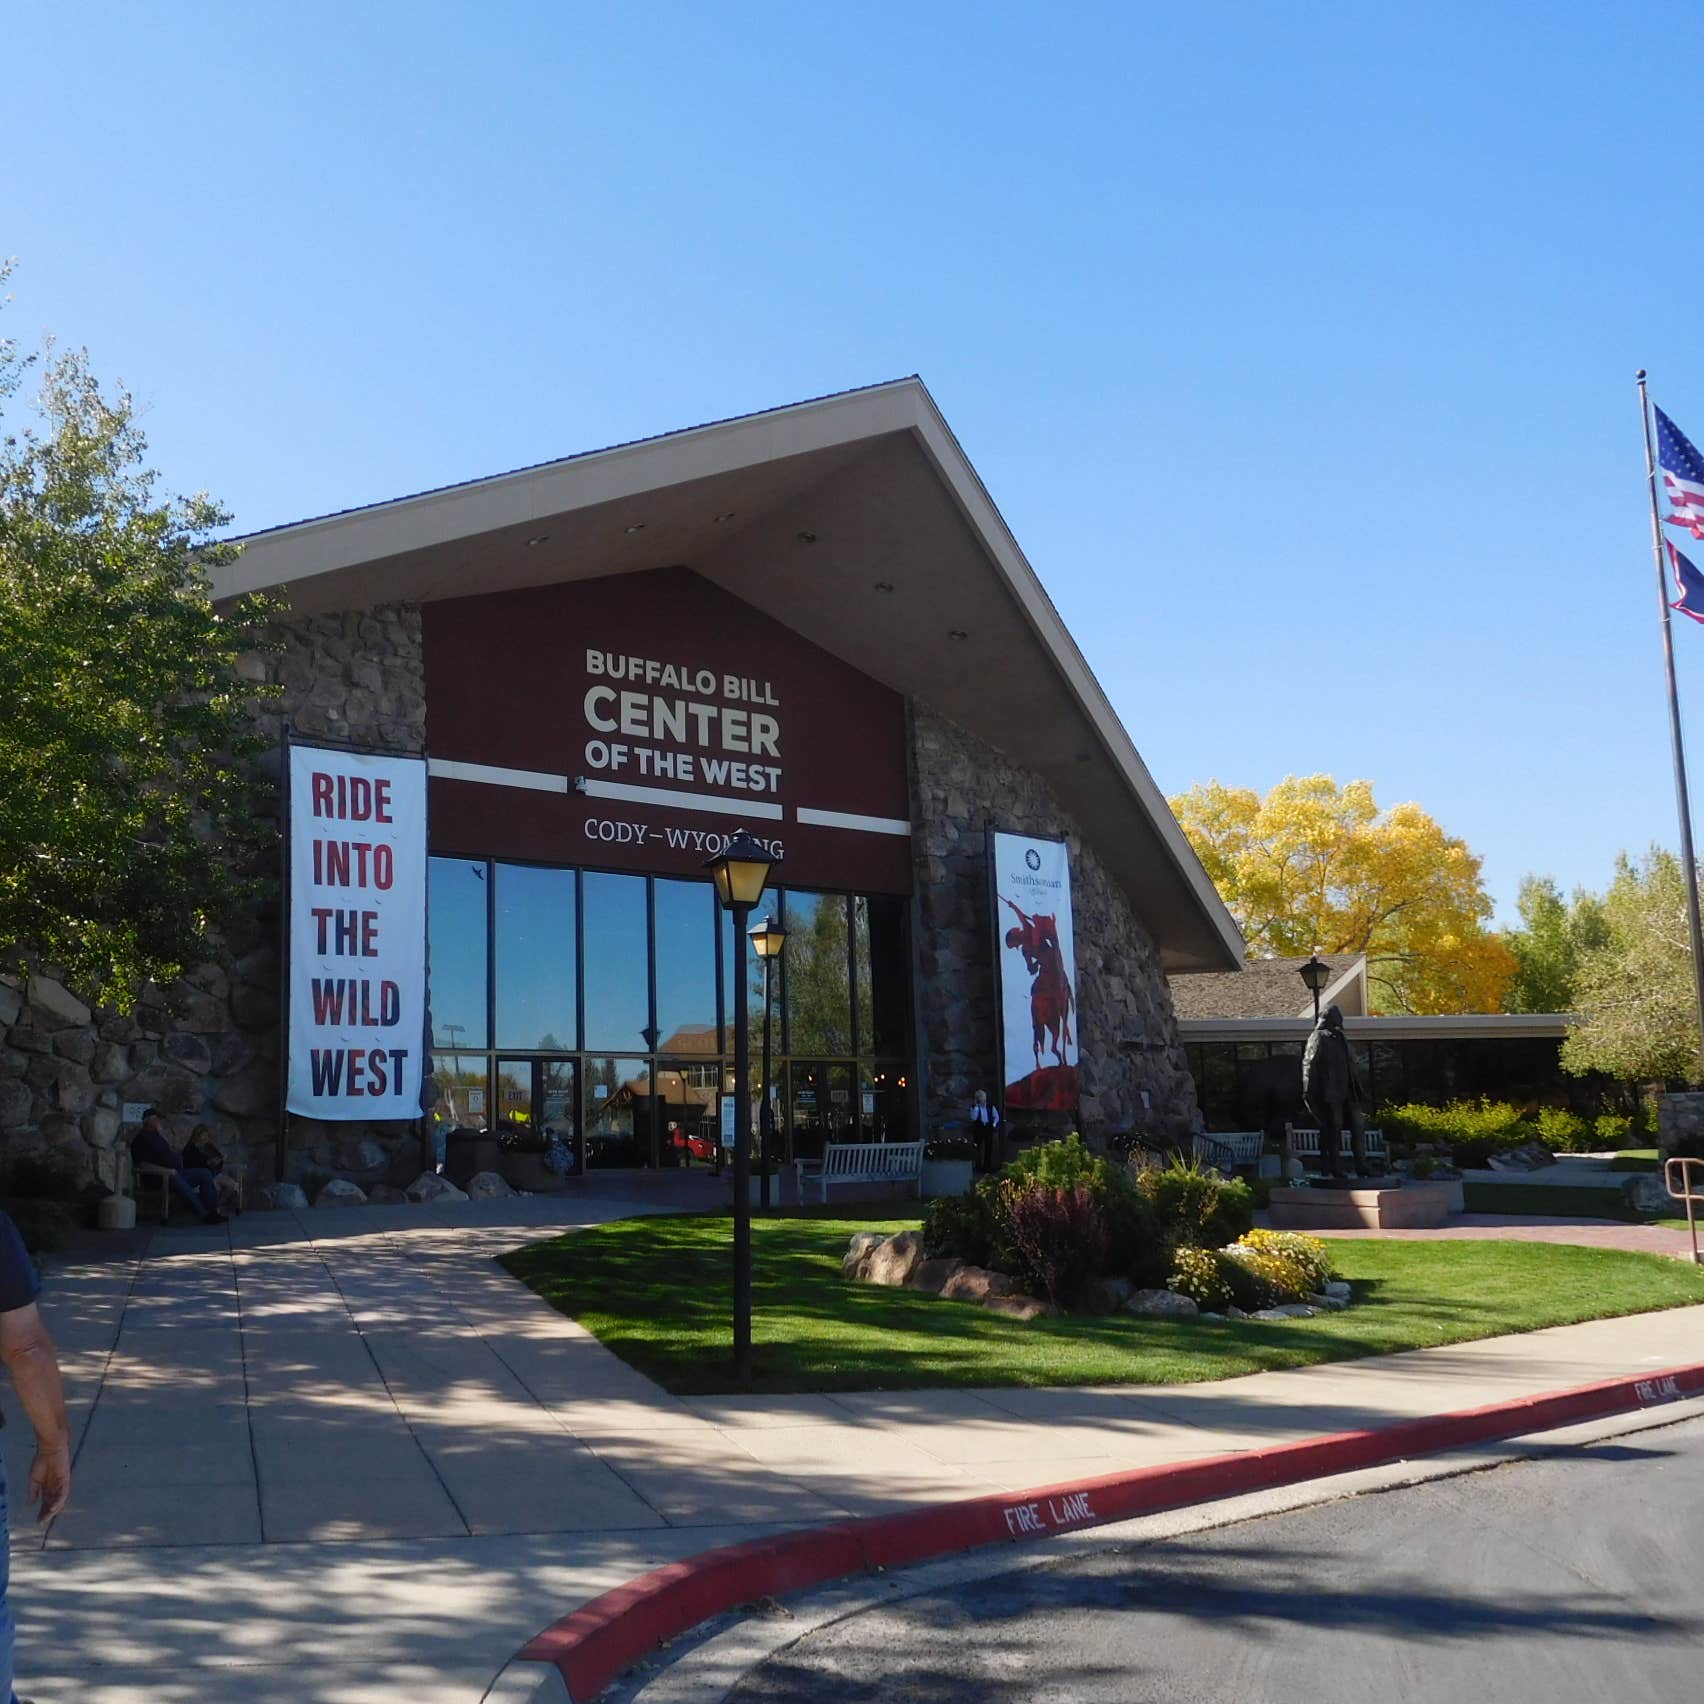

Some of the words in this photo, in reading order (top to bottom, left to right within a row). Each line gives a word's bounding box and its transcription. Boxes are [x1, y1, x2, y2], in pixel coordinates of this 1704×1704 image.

[586, 649, 716, 696] BUFFALO
[723, 674, 779, 706] BILL
[584, 685, 781, 757] CENTER
[585, 740, 628, 770] OF
[634, 747, 694, 781] THE
[700, 757, 782, 793] WEST
[312, 772, 393, 823] RIDE
[313, 839, 393, 890] INTO
[311, 908, 378, 957] THE
[311, 978, 400, 1026] WILD
[310, 1048, 408, 1097] WEST
[1003, 1503, 1046, 1535] FIRE
[1048, 1492, 1096, 1524] LANE
